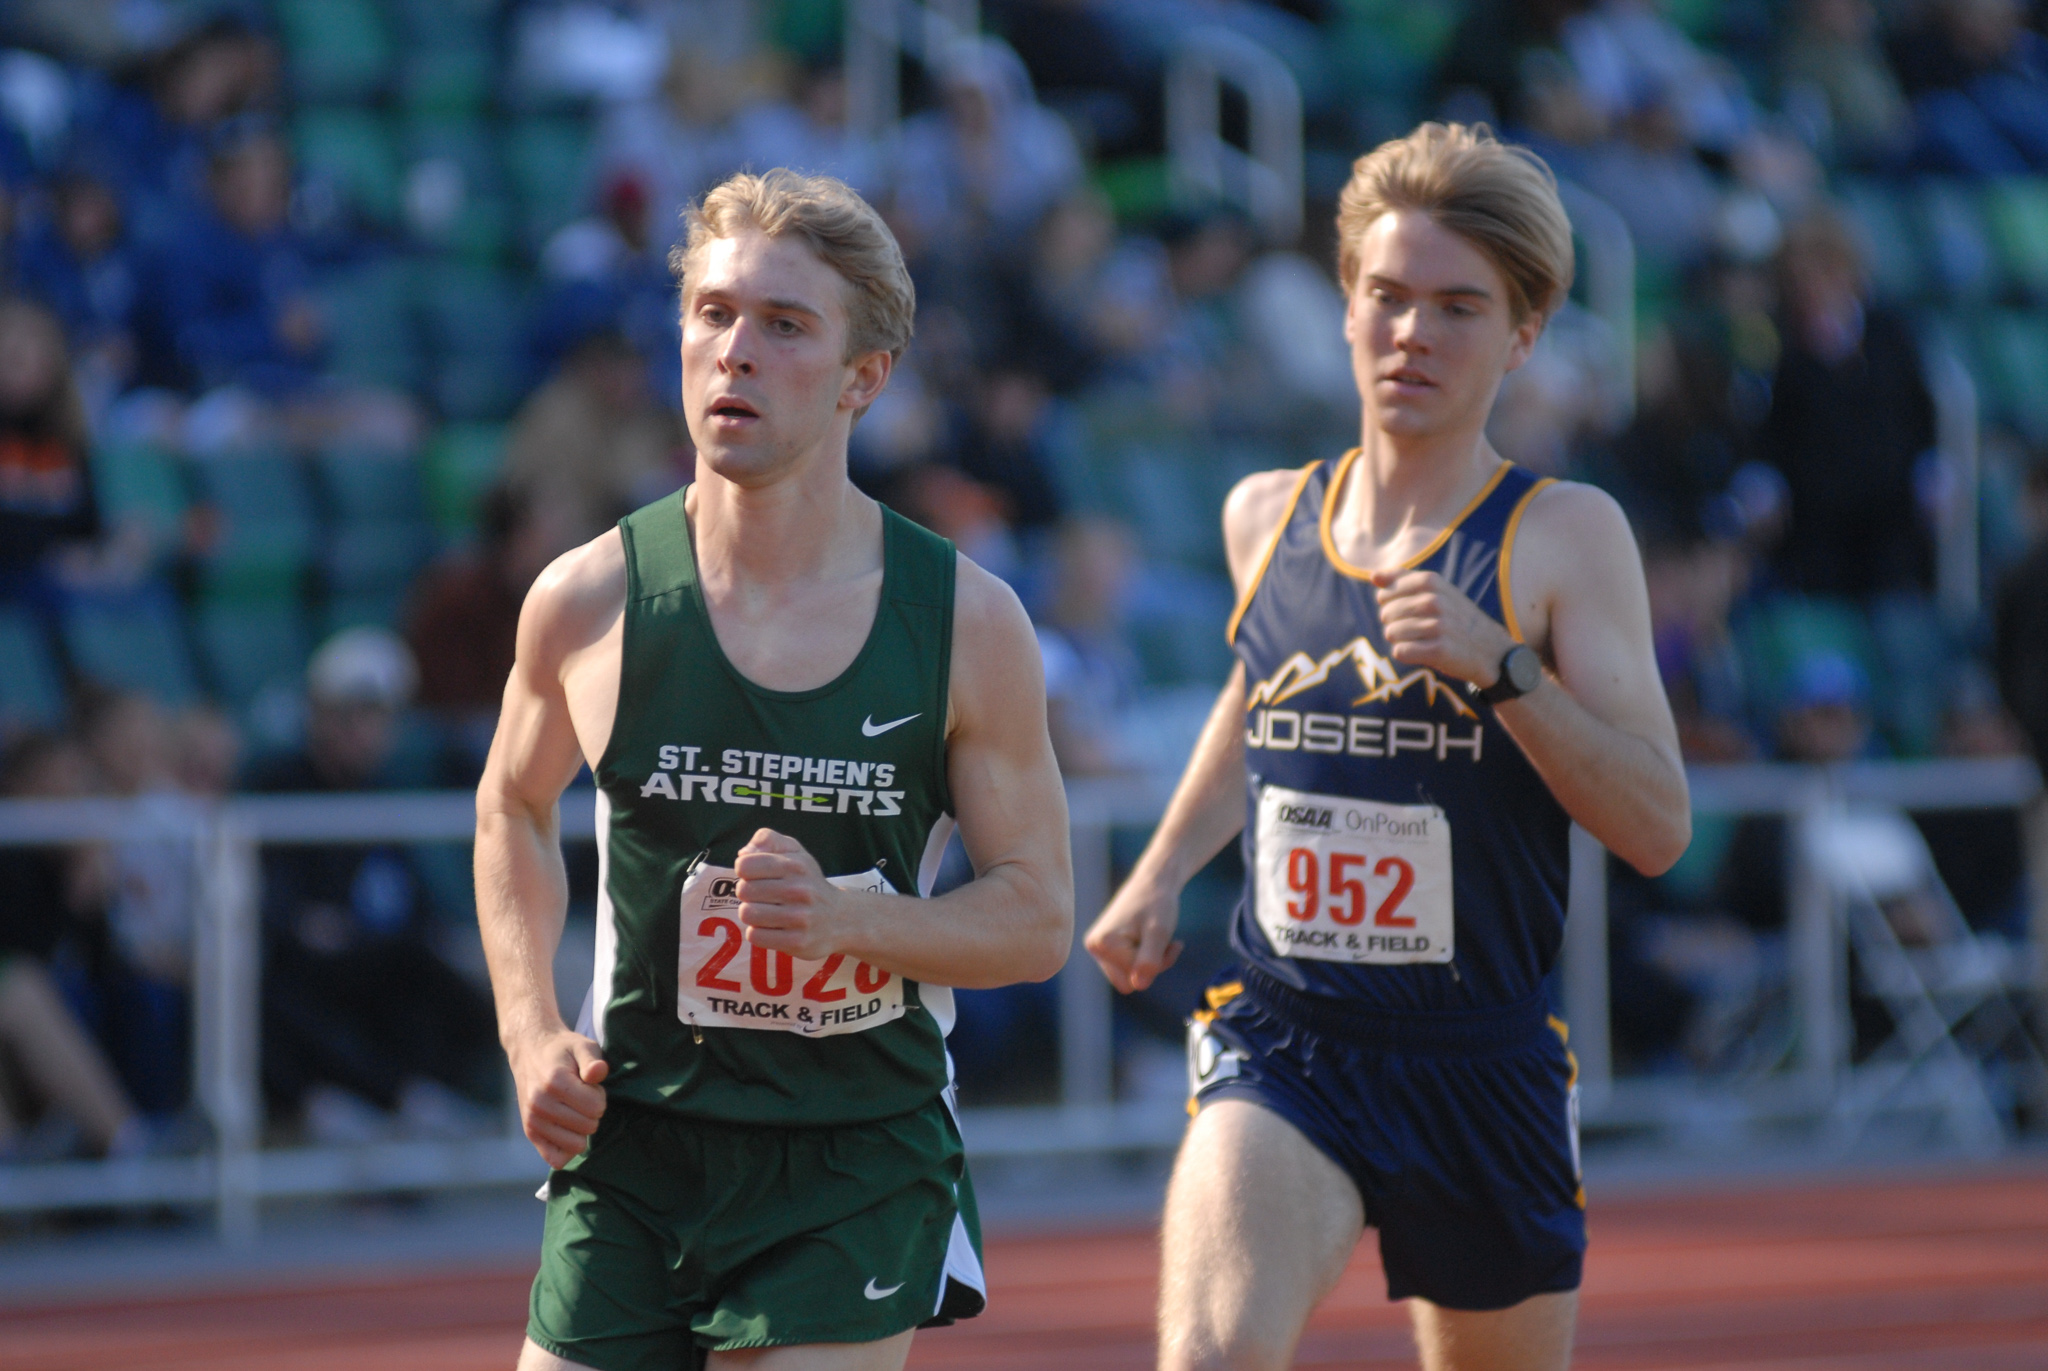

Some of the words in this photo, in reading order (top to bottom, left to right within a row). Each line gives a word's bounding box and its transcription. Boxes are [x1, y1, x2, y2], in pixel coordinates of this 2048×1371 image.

[1246, 709, 1483, 763] JOSEPH
[658, 744, 711, 772] ST.
[721, 749, 896, 787] STEPHEN'S
[640, 772, 905, 816] ARCHERS
[1279, 804, 1333, 829] OSAA
[1345, 808, 1429, 836] OnPoint
[1287, 847, 1417, 928] 952
[1276, 925, 1338, 947] TRACK
[1345, 931, 1361, 949] &
[1367, 935, 1430, 952] FIELD
[707, 996, 789, 1019] TRACK
[797, 1006, 814, 1024] &
[820, 997, 882, 1026] FIELD
